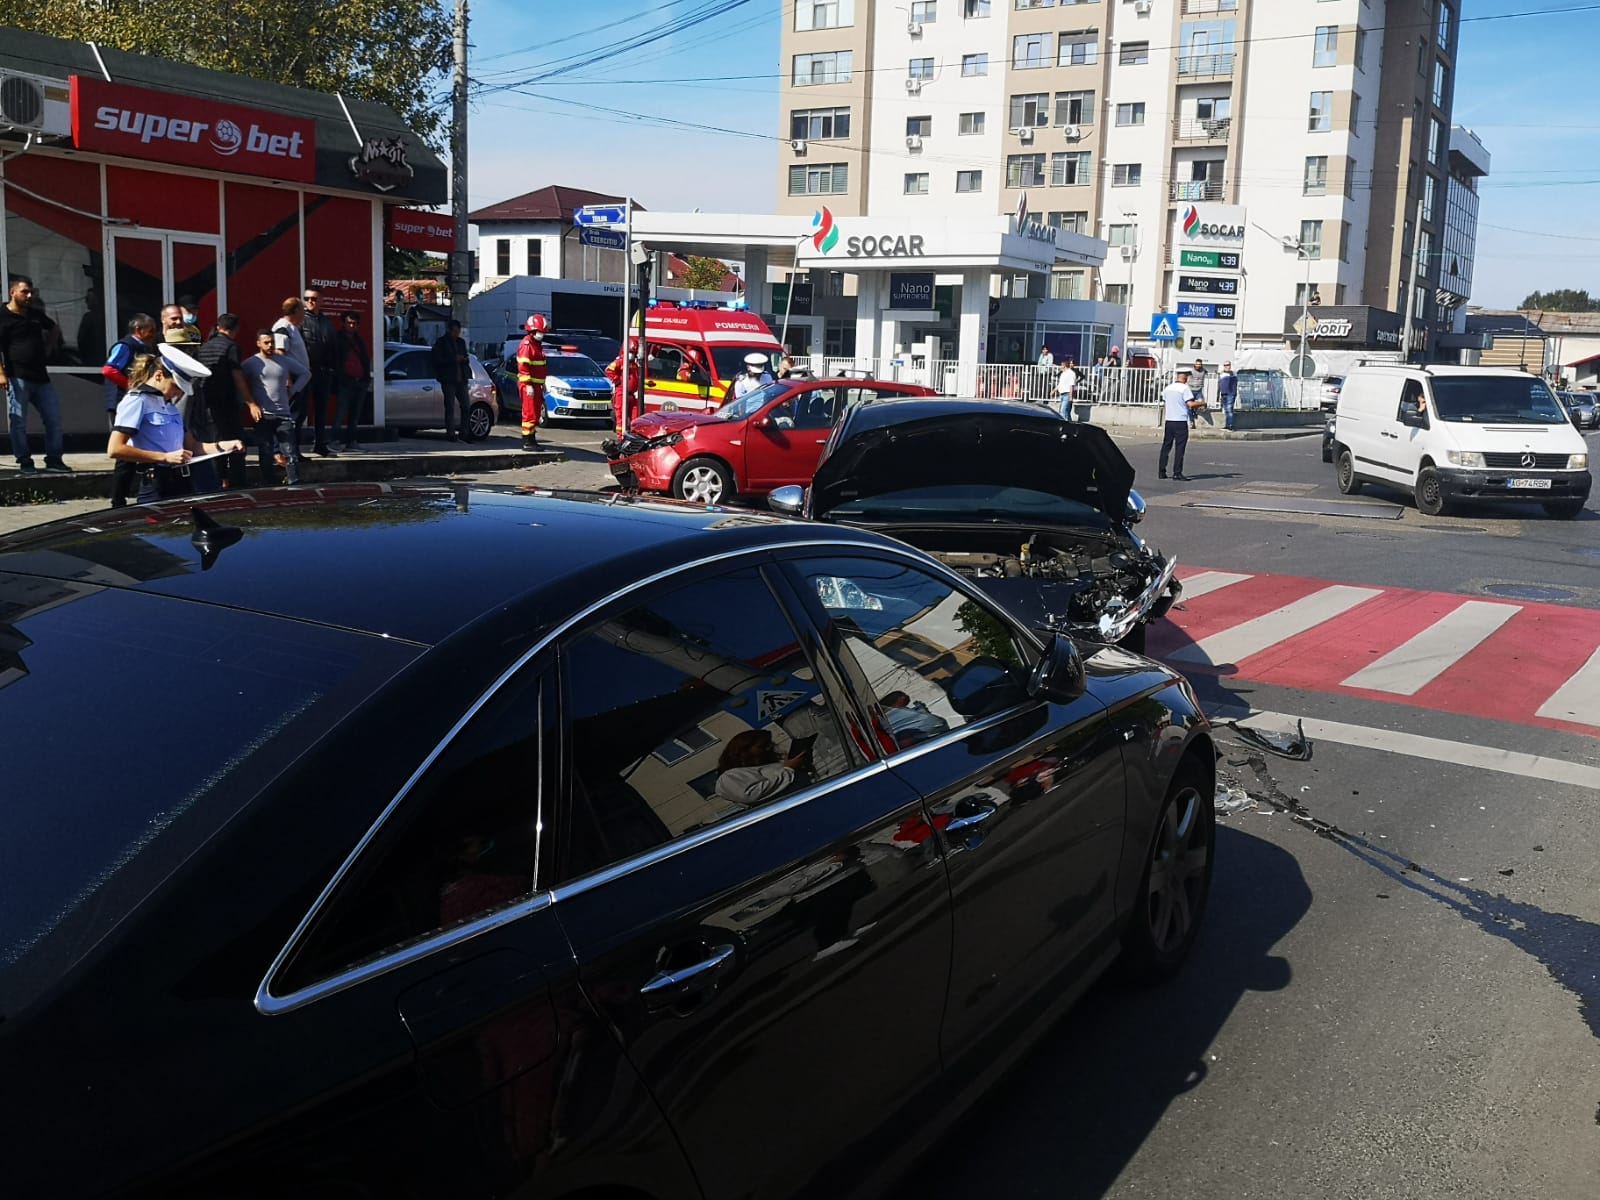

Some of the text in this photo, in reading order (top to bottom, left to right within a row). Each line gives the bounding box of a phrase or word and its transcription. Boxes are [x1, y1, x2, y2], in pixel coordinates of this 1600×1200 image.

[94, 106, 304, 159] super bet
[394, 222, 453, 237] super bet
[1201, 223, 1245, 238] SOCAR
[846, 234, 926, 257] SOCAR
[1187, 253, 1207, 263] Nano
[311, 278, 367, 289] super bet
[901, 282, 930, 294] Nano
[1188, 278, 1209, 287] Nano
[1188, 303, 1210, 312] Nano
